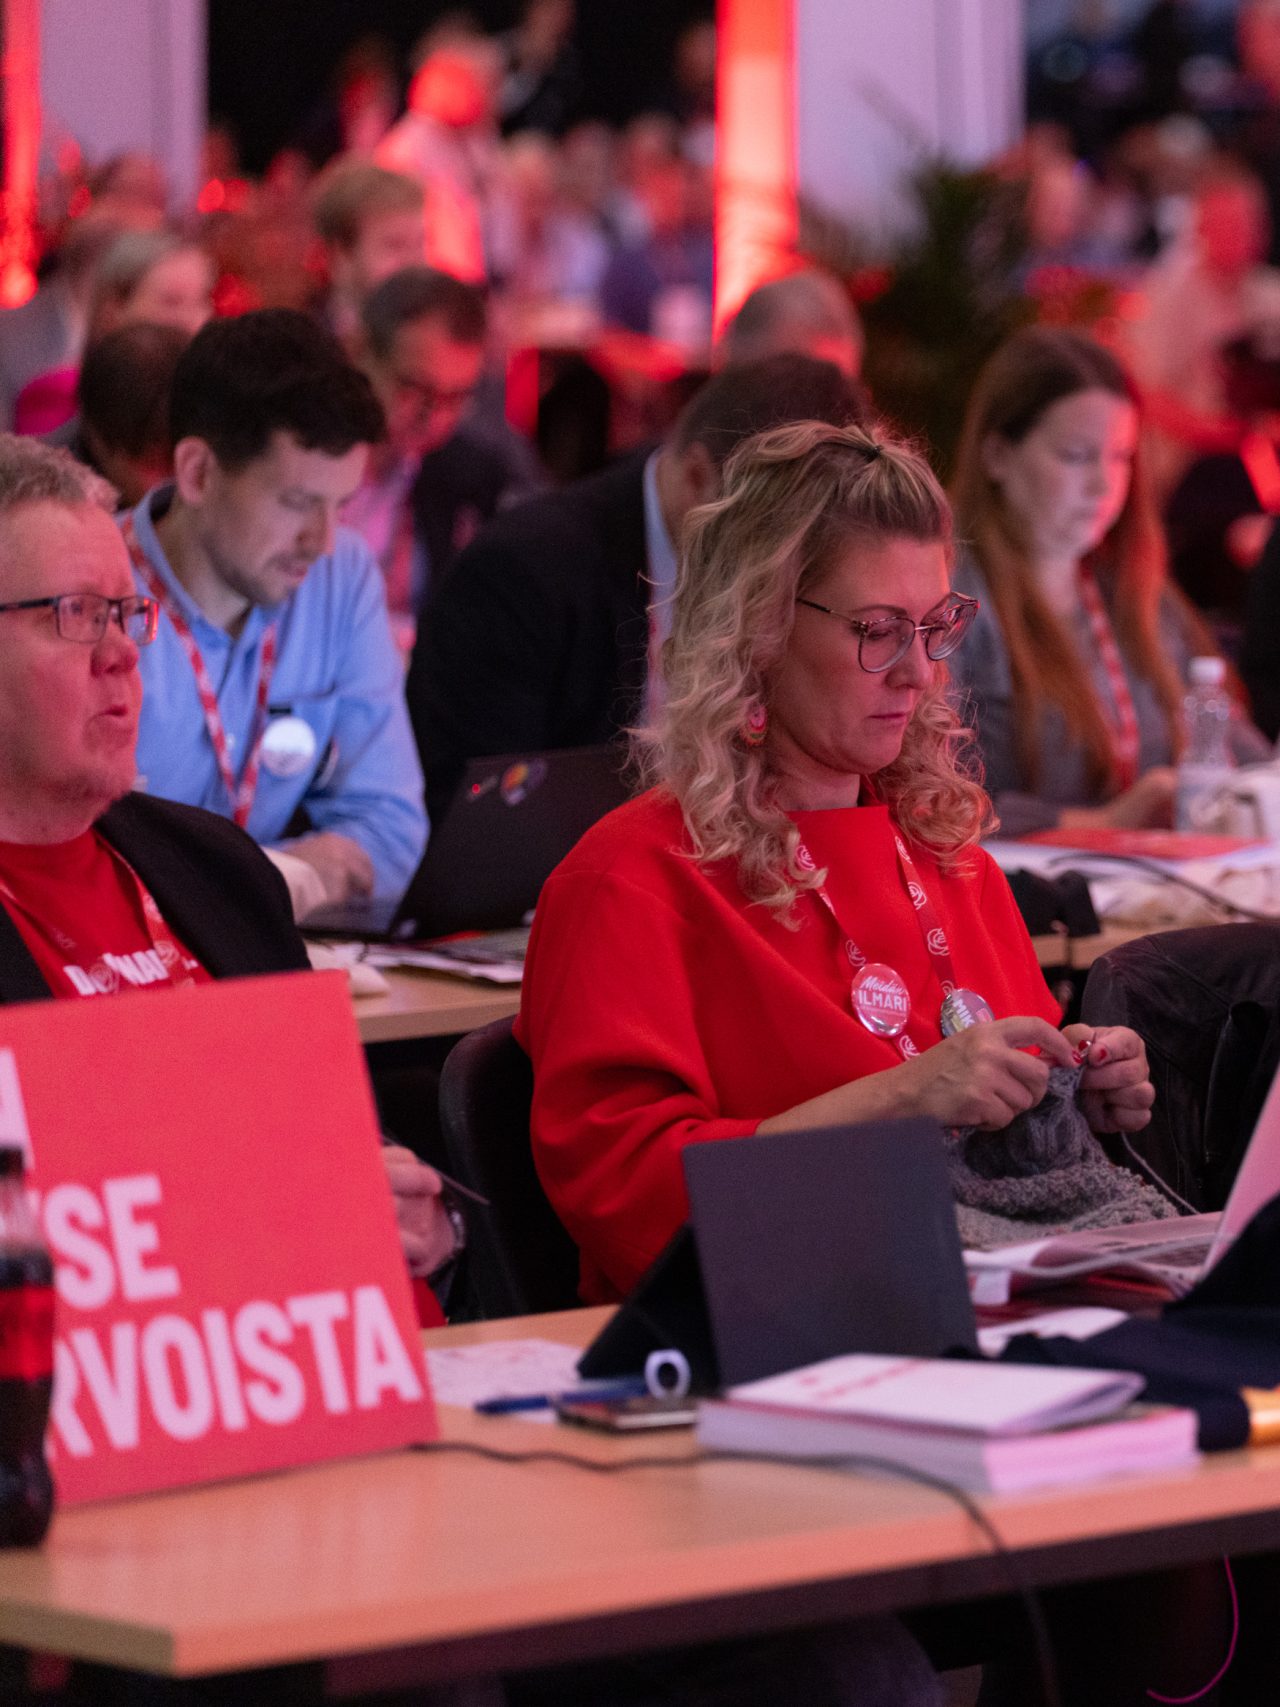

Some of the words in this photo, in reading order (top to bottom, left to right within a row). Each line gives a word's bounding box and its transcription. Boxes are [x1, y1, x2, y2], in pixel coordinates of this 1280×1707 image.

[858, 989, 907, 1012] ILMARI
[34, 1173, 182, 1311] SE
[47, 1284, 424, 1459] RVOISTA
